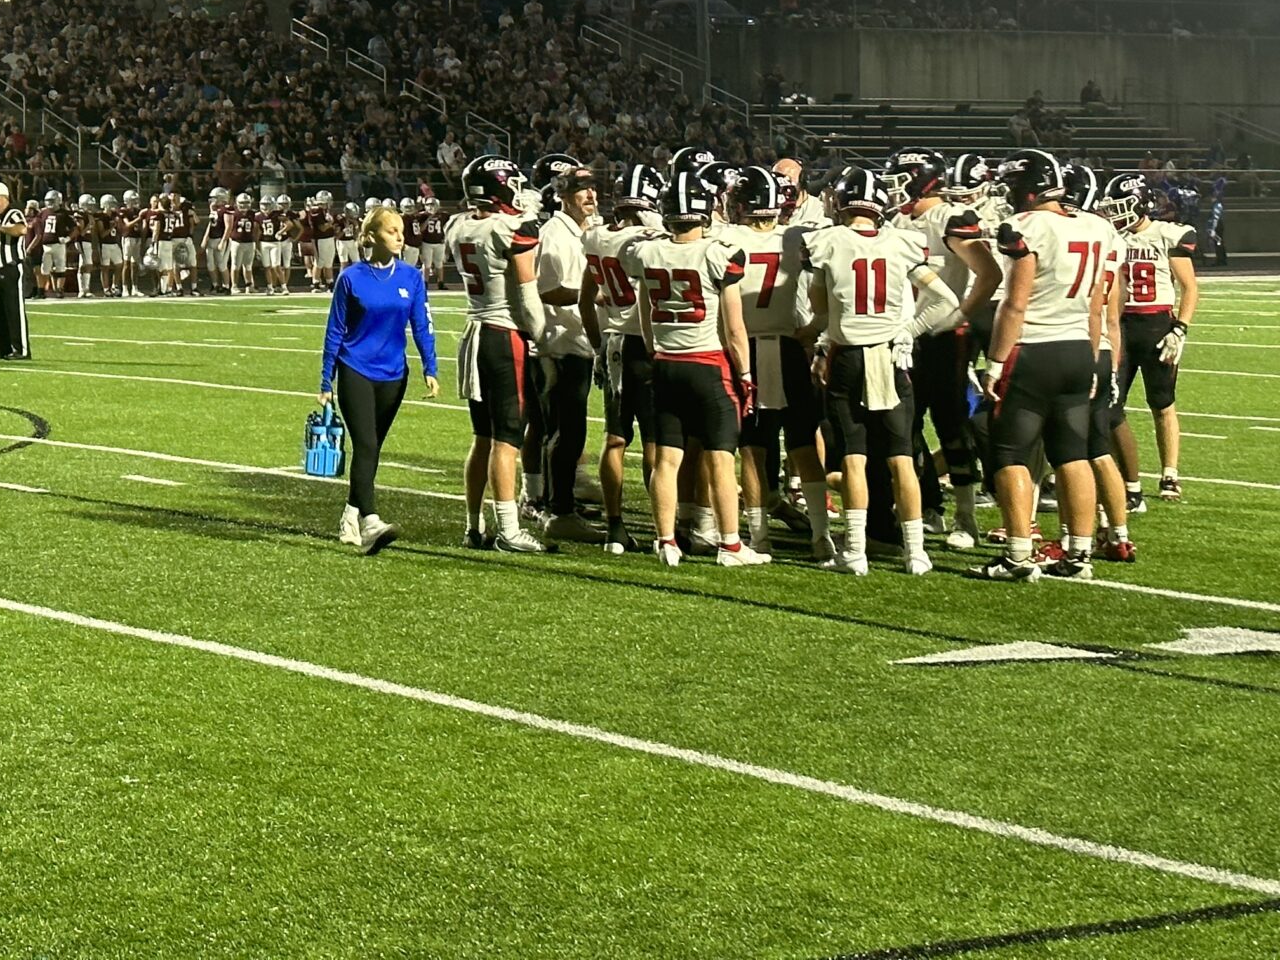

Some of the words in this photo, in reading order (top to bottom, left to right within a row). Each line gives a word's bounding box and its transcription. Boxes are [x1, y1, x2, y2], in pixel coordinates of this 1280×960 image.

[551, 160, 577, 172] GR
[44, 216, 57, 233] 61
[460, 243, 484, 296] 5
[644, 268, 706, 323] 23
[749, 253, 780, 308] 7
[852, 259, 886, 315] 11
